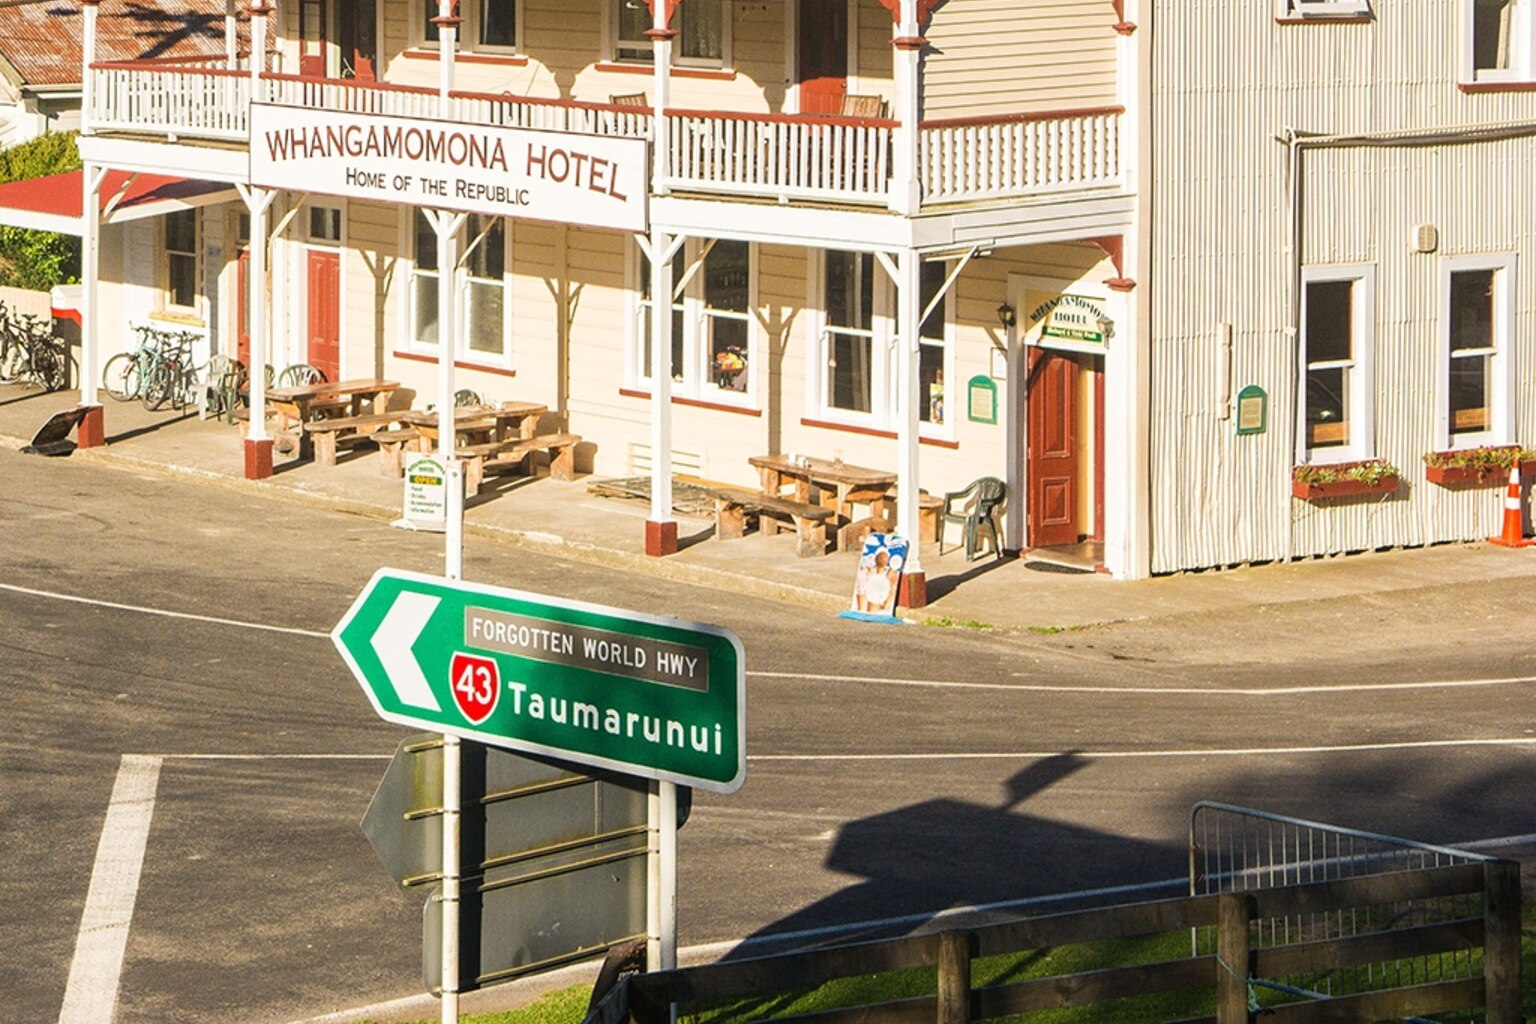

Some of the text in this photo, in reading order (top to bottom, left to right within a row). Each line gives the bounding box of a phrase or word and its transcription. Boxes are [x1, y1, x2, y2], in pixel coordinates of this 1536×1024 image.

[265, 125, 628, 202] WHANGAMOMONA HOTEL
[345, 167, 530, 206] HOME OF THE REPUBLIC
[415, 476, 437, 485] OPEN
[472, 617, 698, 678] FORGOTTEN WORLD HWY
[456, 664, 492, 705] 43
[508, 681, 723, 755] Taumarunui
